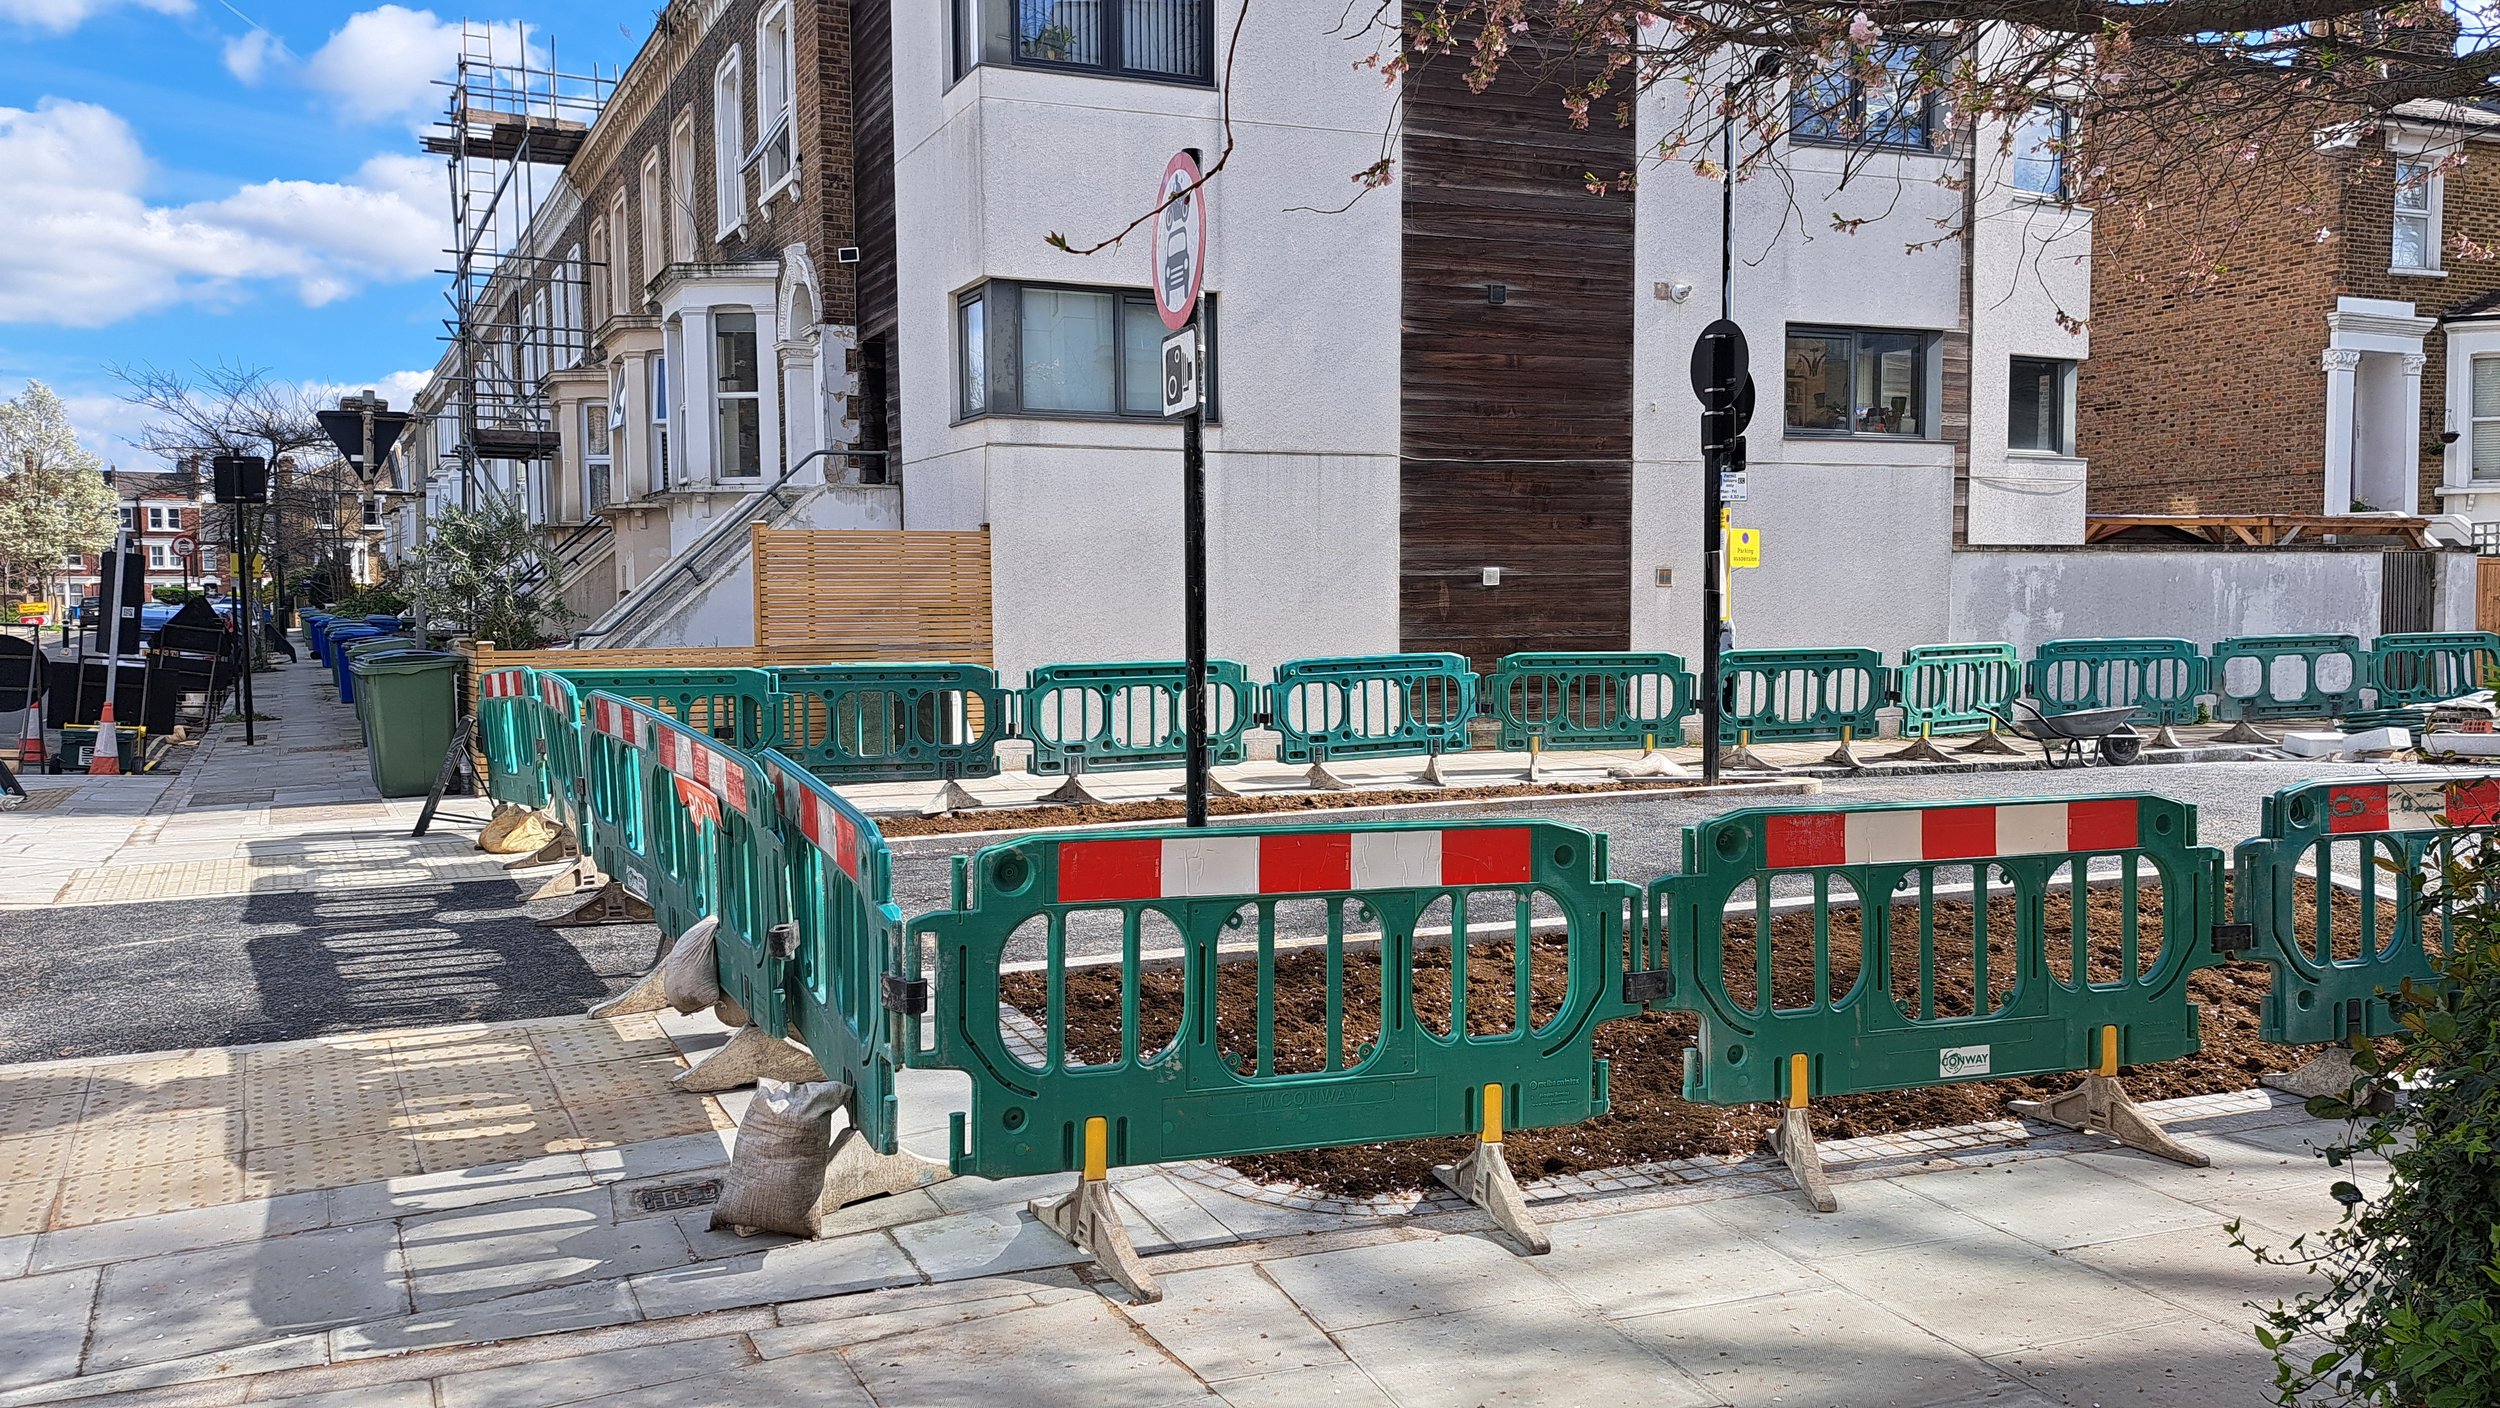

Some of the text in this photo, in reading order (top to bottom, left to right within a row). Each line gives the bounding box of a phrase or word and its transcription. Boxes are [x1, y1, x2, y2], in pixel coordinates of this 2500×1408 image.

[1737, 547, 1754, 555] Parking
[1941, 1053, 1989, 1067] CONWAY
[1244, 1087, 1359, 1109] F M CONWAY
